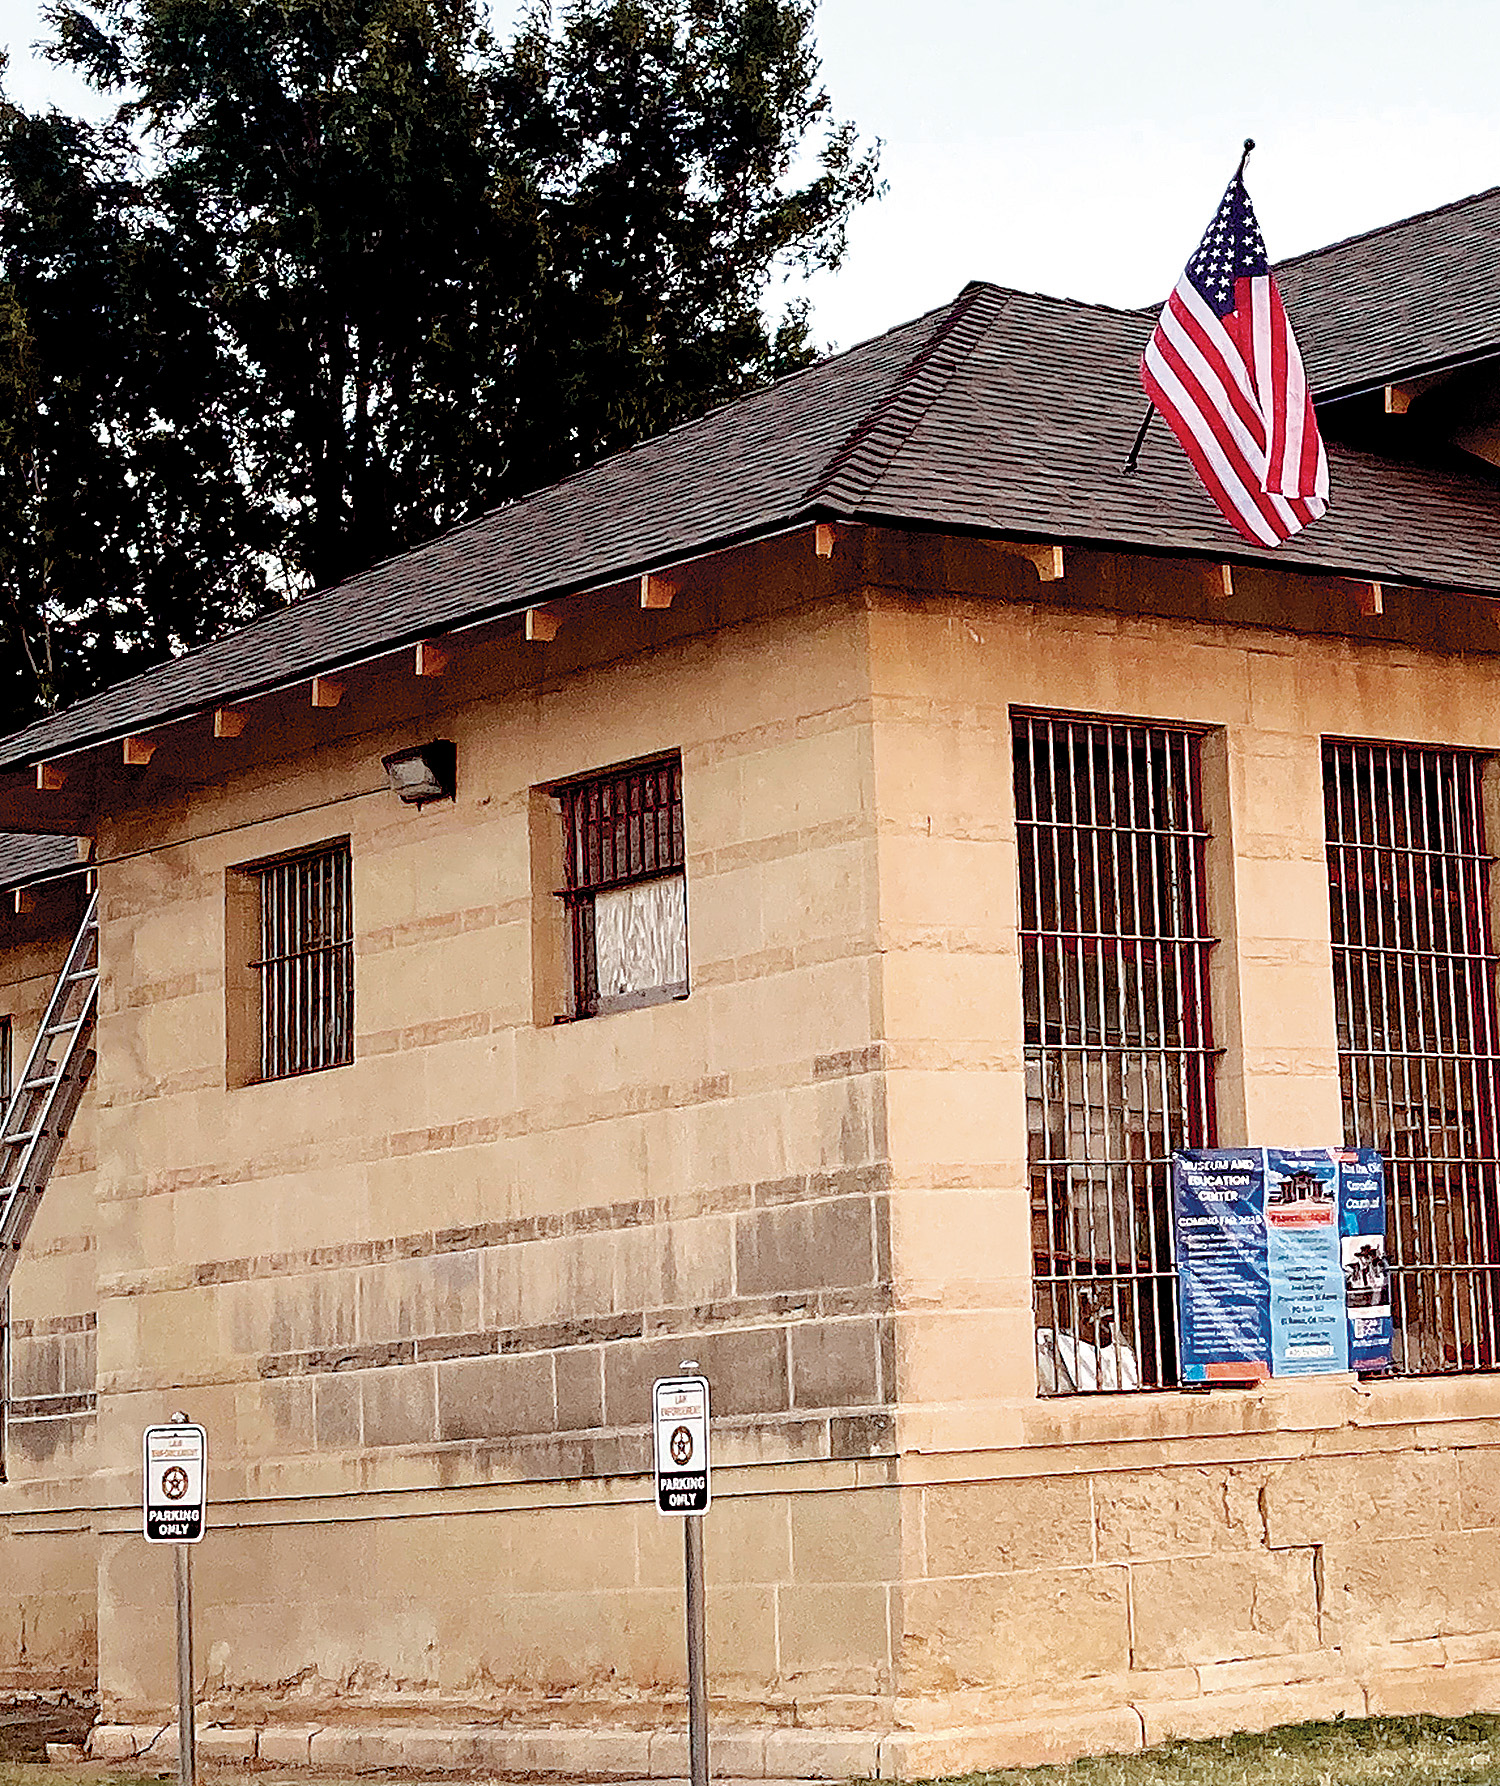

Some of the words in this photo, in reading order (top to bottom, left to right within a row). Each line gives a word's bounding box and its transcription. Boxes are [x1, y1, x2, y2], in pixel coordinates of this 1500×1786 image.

[1181, 1160, 1229, 1171] MUSEUM
[1231, 1159, 1255, 1170] AND
[1188, 1175, 1250, 1186] EDUCATION
[1198, 1190, 1238, 1202] CENTER
[660, 1477, 705, 1491] PARKING
[669, 1493, 697, 1506] ONLY
[149, 1510, 199, 1522] PARKING
[158, 1523, 189, 1536] ONLY
